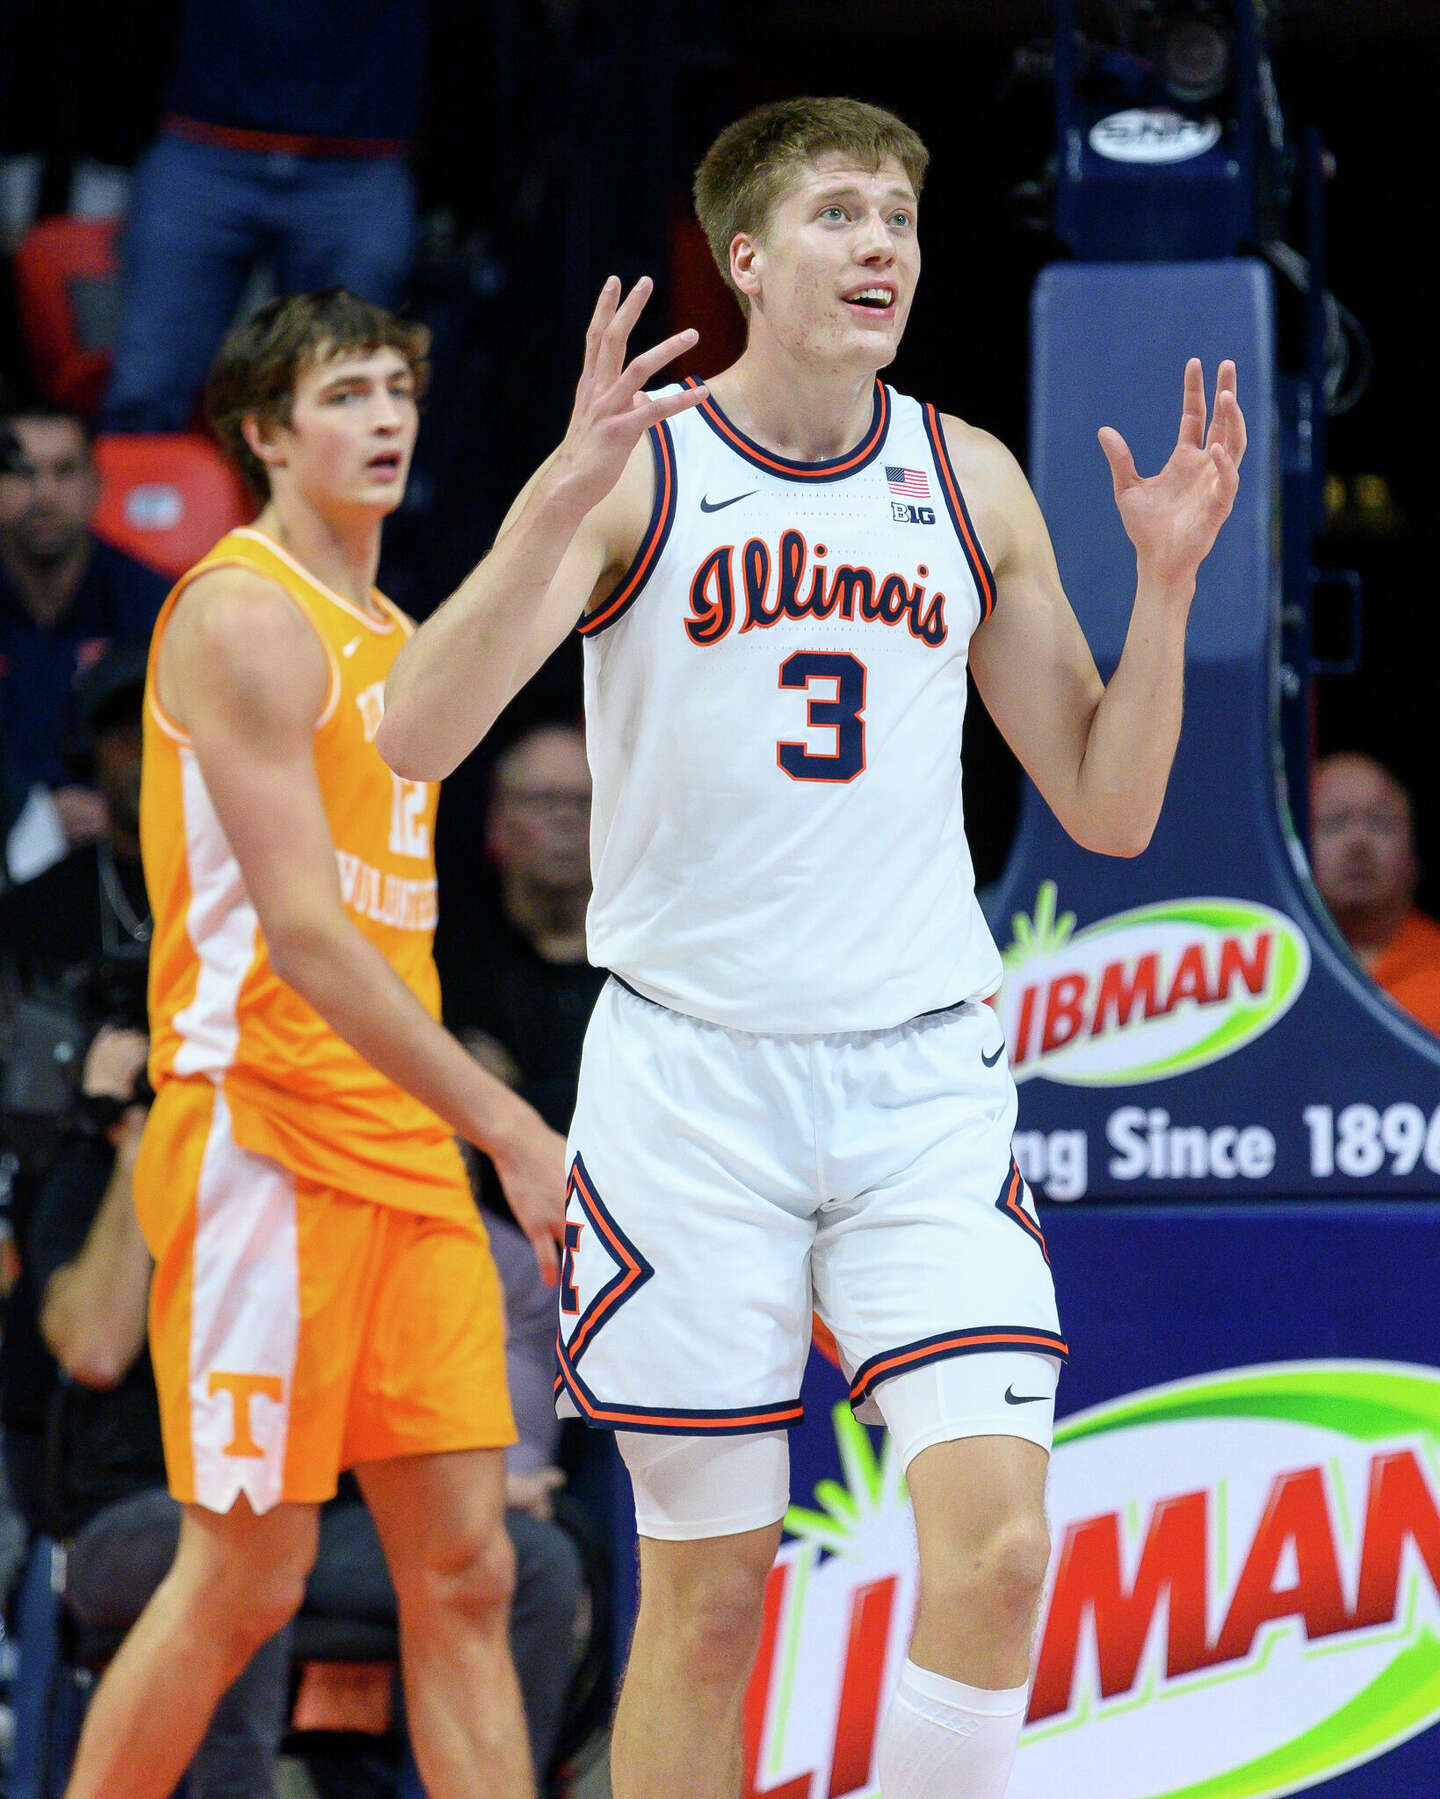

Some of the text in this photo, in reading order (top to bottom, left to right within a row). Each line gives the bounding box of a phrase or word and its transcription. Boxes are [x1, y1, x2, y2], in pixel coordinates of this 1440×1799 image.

[684, 528, 948, 648] Illinois
[776, 650, 868, 784] 3
[983, 931, 1275, 1066] IBMAN
[1105, 1104, 1277, 1180] Since
[208, 1372, 283, 1459] T
[740, 1447, 1440, 1799] LIMAN
